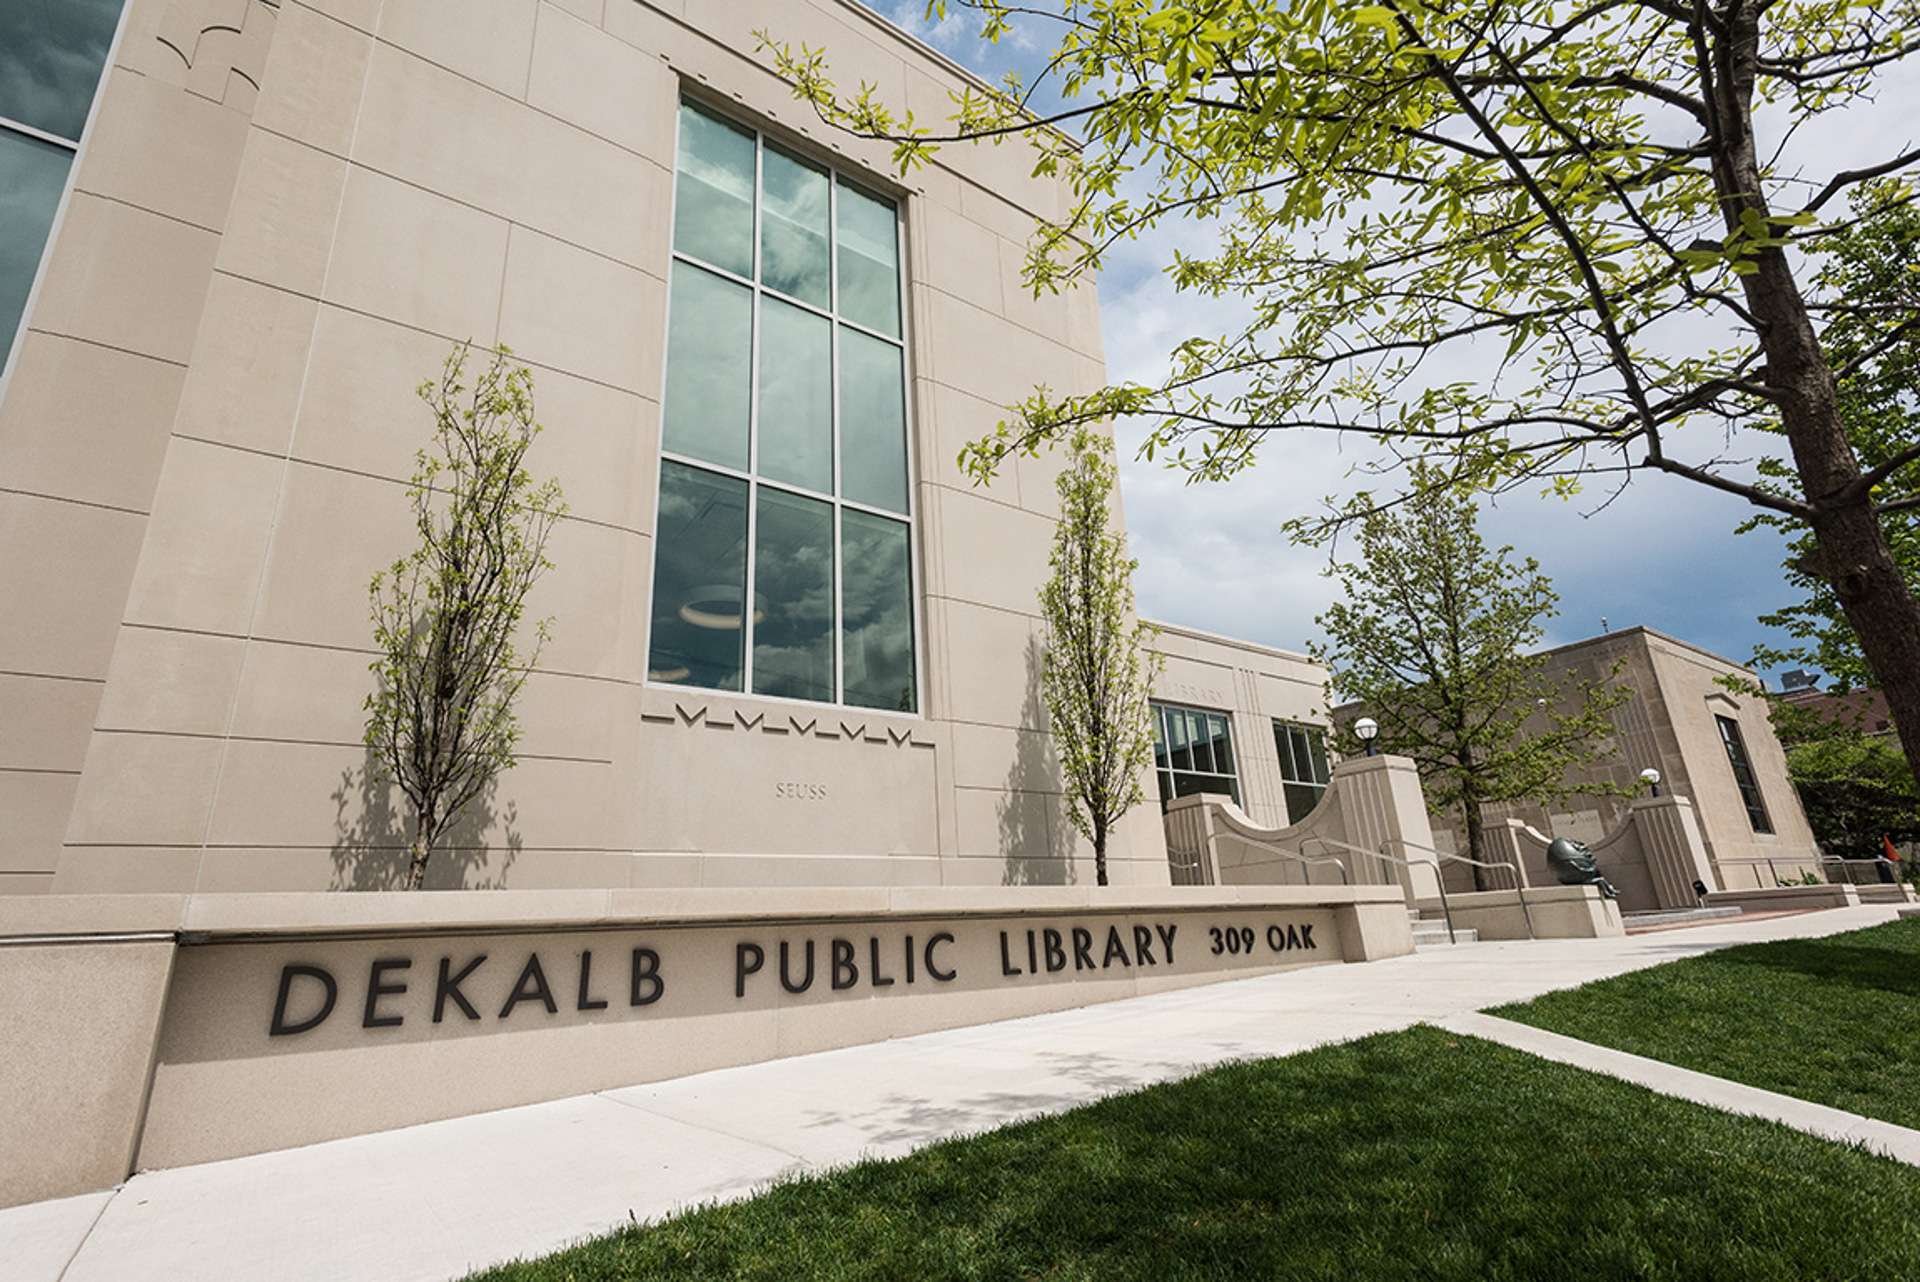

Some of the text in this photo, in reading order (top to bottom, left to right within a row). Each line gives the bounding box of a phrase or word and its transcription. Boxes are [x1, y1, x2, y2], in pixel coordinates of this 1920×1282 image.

[776, 782, 827, 800] SEUSS
[269, 923, 1318, 1038] DEKALB PUBLIC LIBRARY 309 OAK
